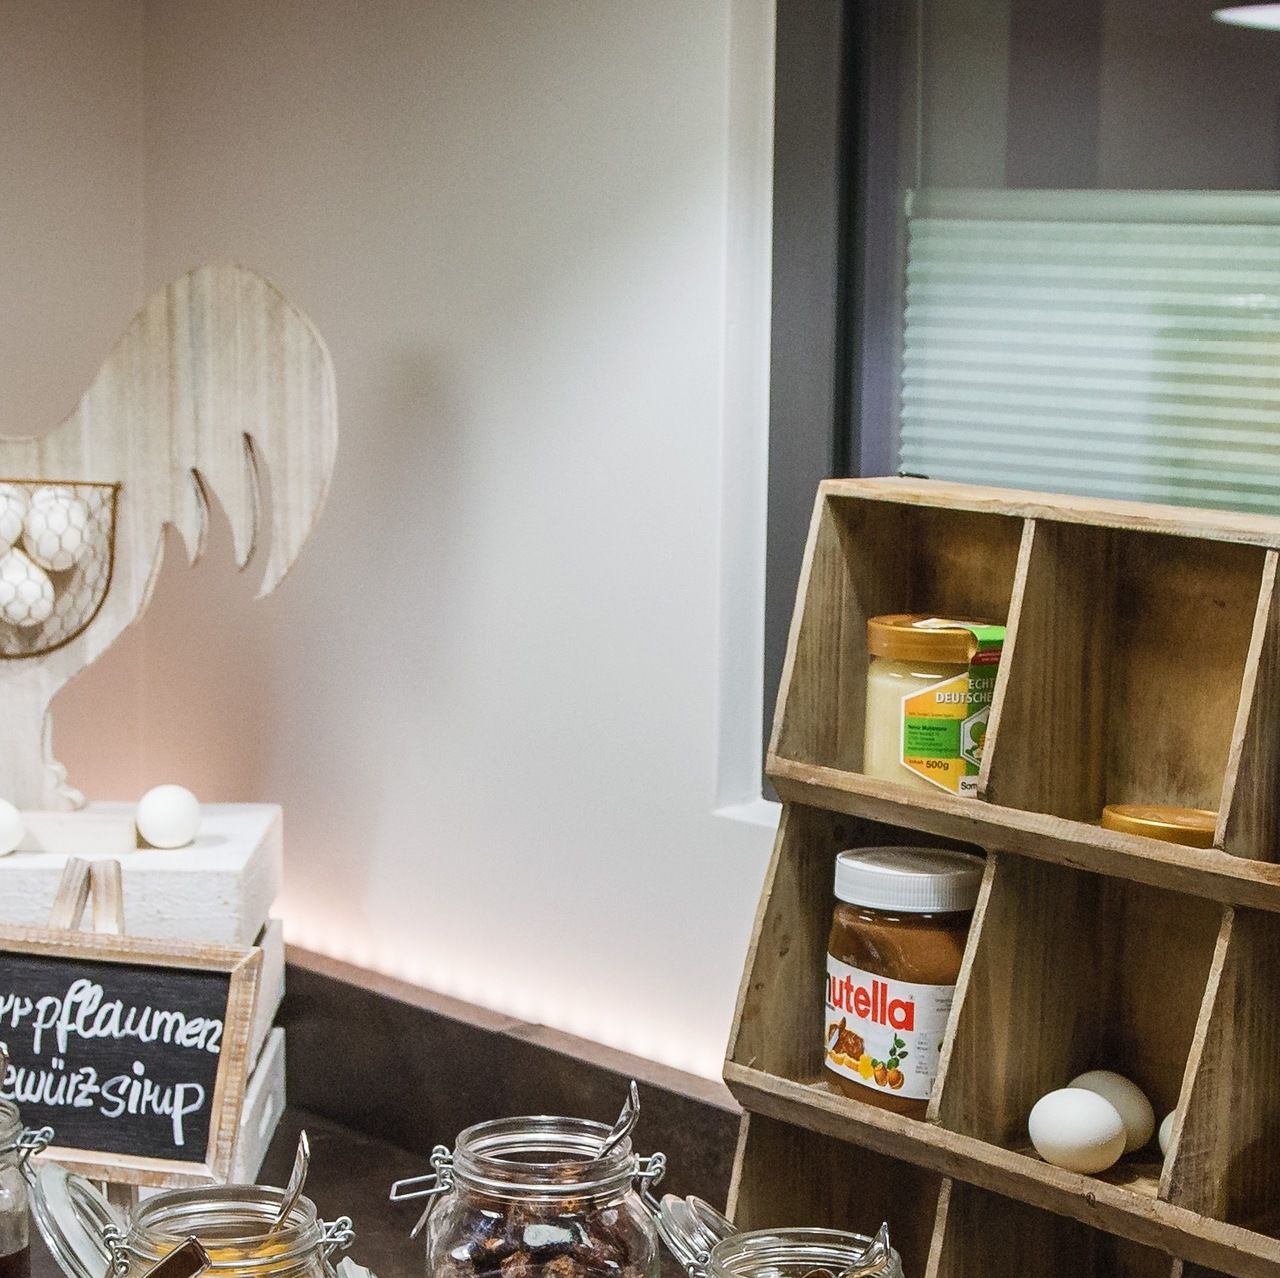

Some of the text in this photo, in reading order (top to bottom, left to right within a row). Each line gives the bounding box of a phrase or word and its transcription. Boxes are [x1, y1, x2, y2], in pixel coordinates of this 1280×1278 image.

[969, 678, 995, 690] ECHT
[935, 691, 993, 704] DEUTSCHE
[925, 760, 950, 771] 500g
[960, 781, 978, 791] Som
[826, 971, 916, 1032] nutella
